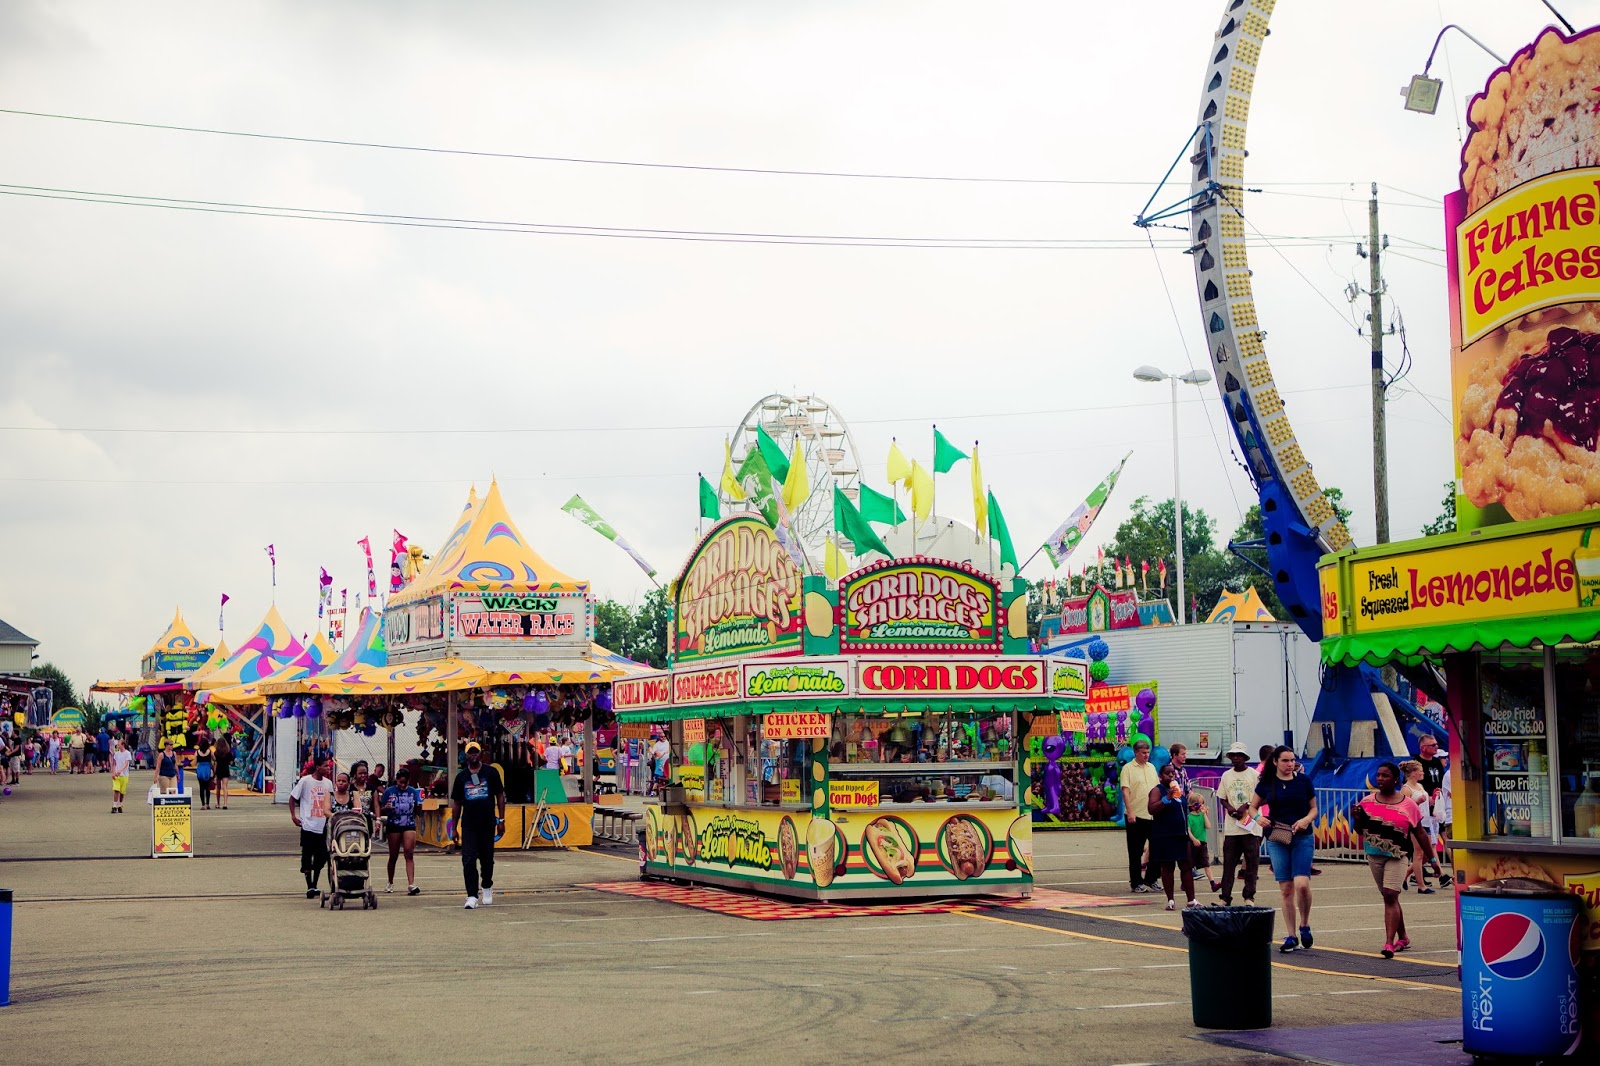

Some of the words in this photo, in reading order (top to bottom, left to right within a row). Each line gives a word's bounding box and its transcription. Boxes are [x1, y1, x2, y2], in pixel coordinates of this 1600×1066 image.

[1473, 245, 1600, 315] Cakes
[682, 530, 735, 619] CORN
[738, 526, 797, 597] DOGS
[1368, 567, 1399, 592] Fresh
[1407, 547, 1575, 609] Lemonade
[849, 572, 919, 611] CORN
[921, 572, 991, 613] DOGS
[1361, 590, 1410, 620] Squeezed
[686, 570, 792, 648] SAUSAGES
[856, 596, 983, 629] SAUSAGES
[461, 613, 523, 634] WATER
[530, 614, 574, 635] RACE
[871, 623, 969, 638] Lemonade
[704, 622, 769, 653] Lemonade
[677, 670, 739, 700] SAUSAGES
[749, 671, 845, 695] Lemonade
[863, 666, 951, 690] CORN
[956, 665, 1037, 690] DOGS
[616, 683, 640, 705] CHILI
[643, 680, 668, 703] DOGS
[1092, 686, 1128, 699] PRIZE
[767, 714, 827, 726] CHICKEN
[1492, 708, 1512, 721] Deep
[1514, 707, 1536, 720] Fried
[768, 727, 780, 736] ON
[786, 728, 792, 736] A
[796, 726, 827, 736] STICK
[1485, 722, 1518, 734] OREO'S
[1520, 721, 1544, 734] $6.00
[1495, 777, 1516, 790] Deep
[1518, 777, 1540, 790] Fried
[830, 792, 852, 804] Corn
[854, 792, 878, 806] Dogs
[1496, 792, 1540, 806] TWINKIES
[1506, 807, 1530, 820] $6.00
[1471, 990, 1480, 1030] pepsi
[1558, 994, 1568, 1034] pepsi
